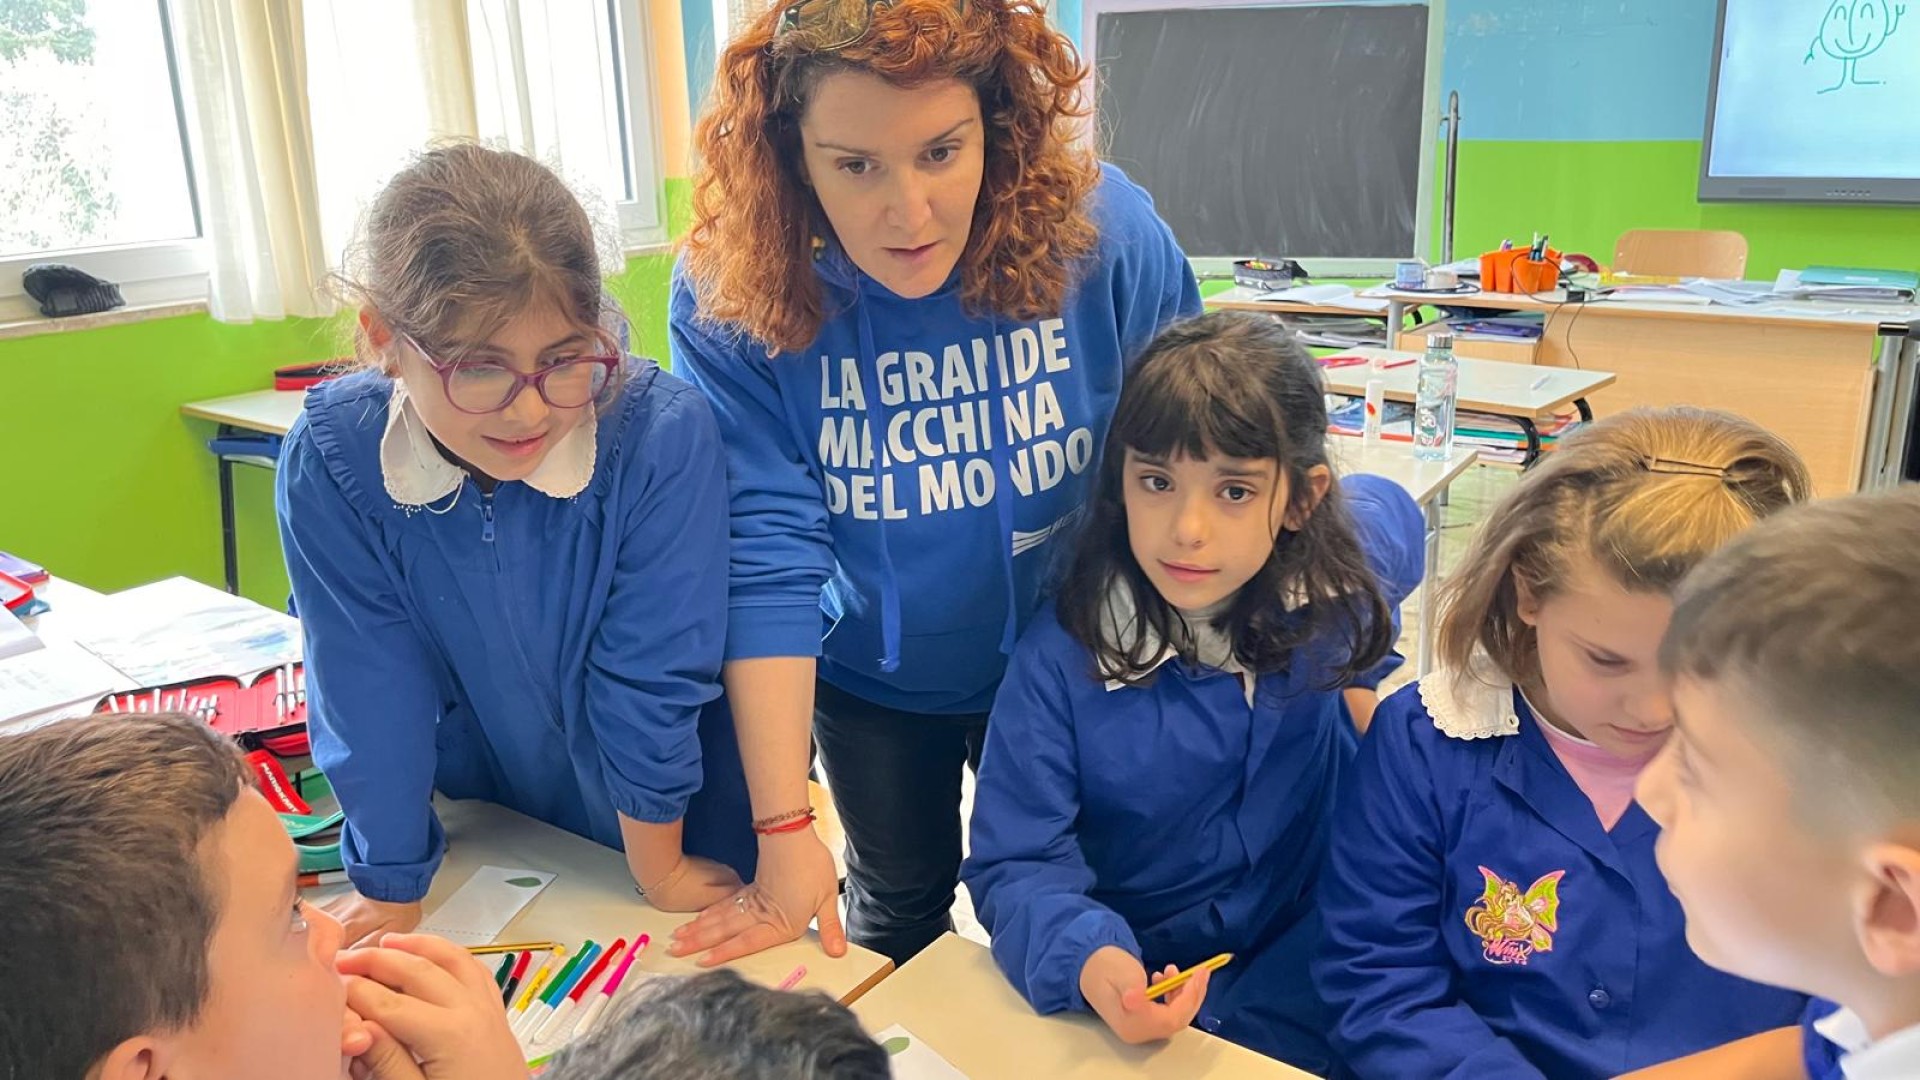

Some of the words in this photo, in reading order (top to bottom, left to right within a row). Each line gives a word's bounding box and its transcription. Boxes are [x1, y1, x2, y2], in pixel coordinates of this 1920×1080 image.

[821, 355, 867, 410] LA
[876, 318, 1070, 406] GRANDE
[818, 381, 1064, 468] MACCHINA
[824, 471, 907, 520] DEL
[919, 428, 1093, 514] MONDO
